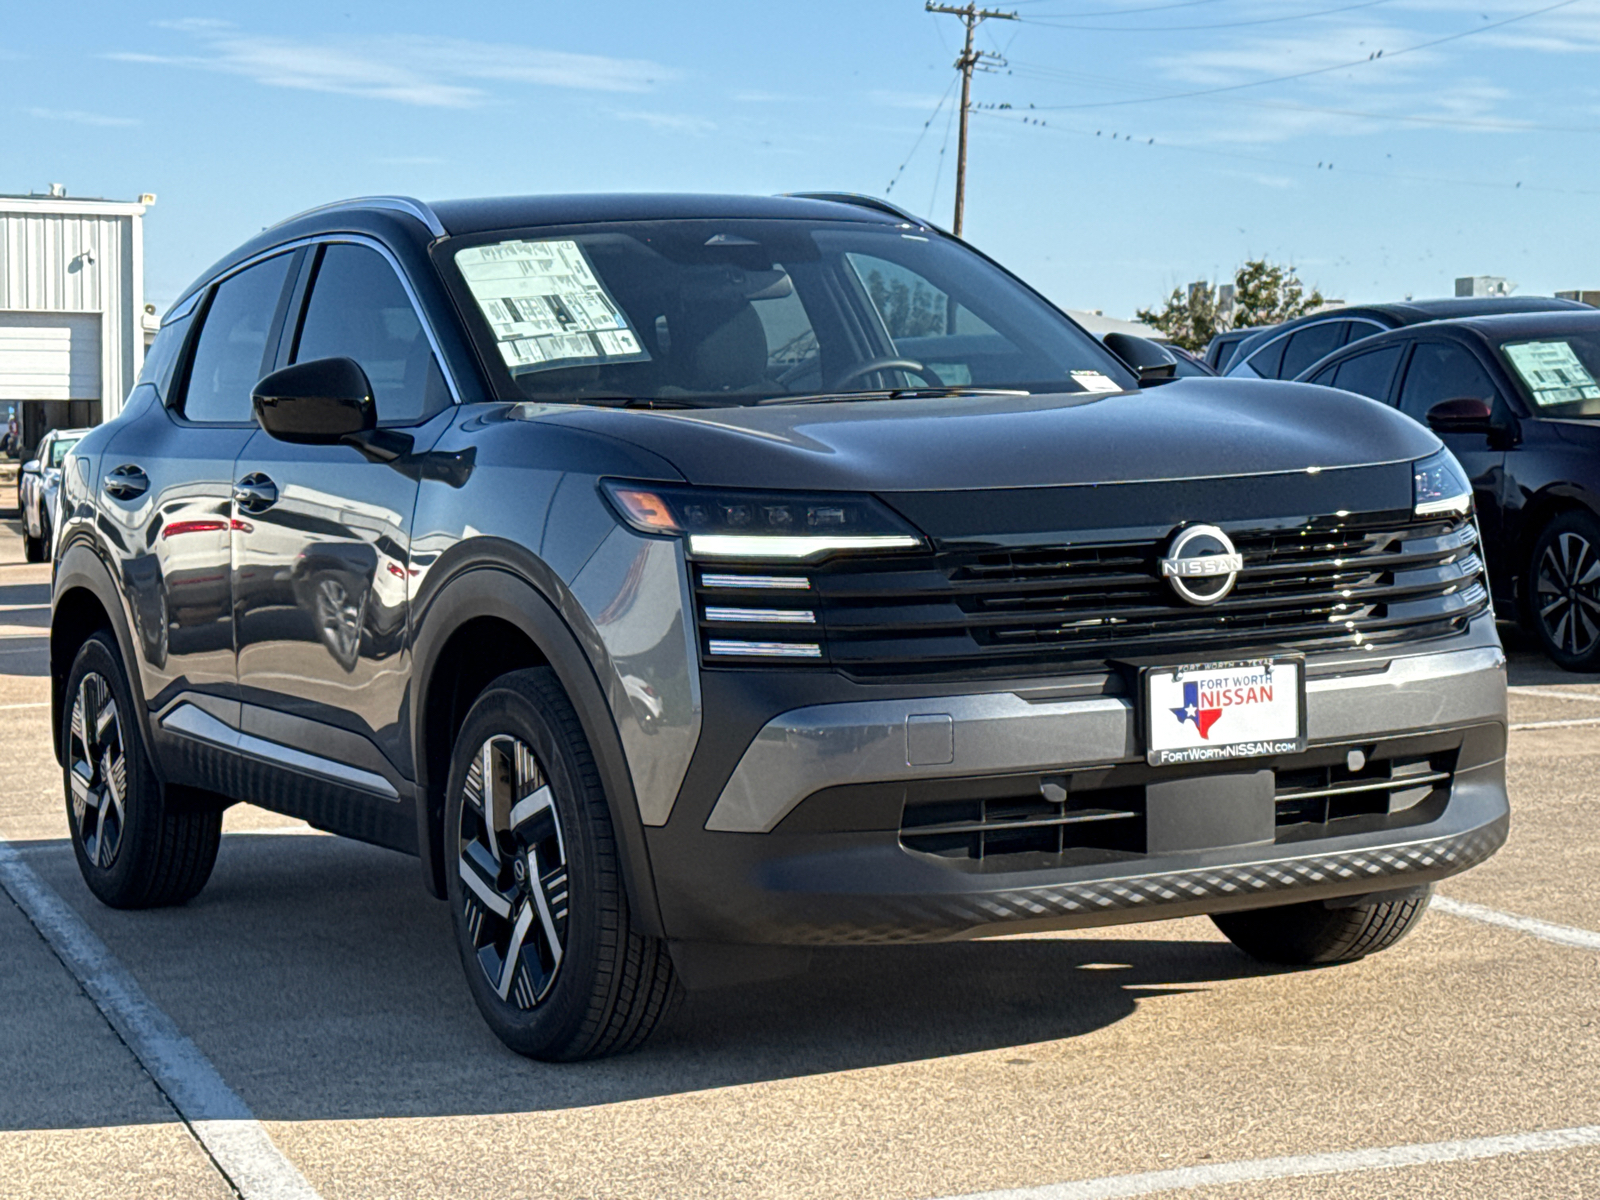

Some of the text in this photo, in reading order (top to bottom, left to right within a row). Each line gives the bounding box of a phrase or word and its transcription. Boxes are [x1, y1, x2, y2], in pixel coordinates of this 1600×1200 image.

[1164, 558, 1241, 574] NISSAN
[1178, 663, 1200, 672] FORT
[1204, 661, 1235, 671] WORTH
[1200, 674, 1273, 690] FORT WORTH
[1201, 685, 1273, 708] NISSAN
